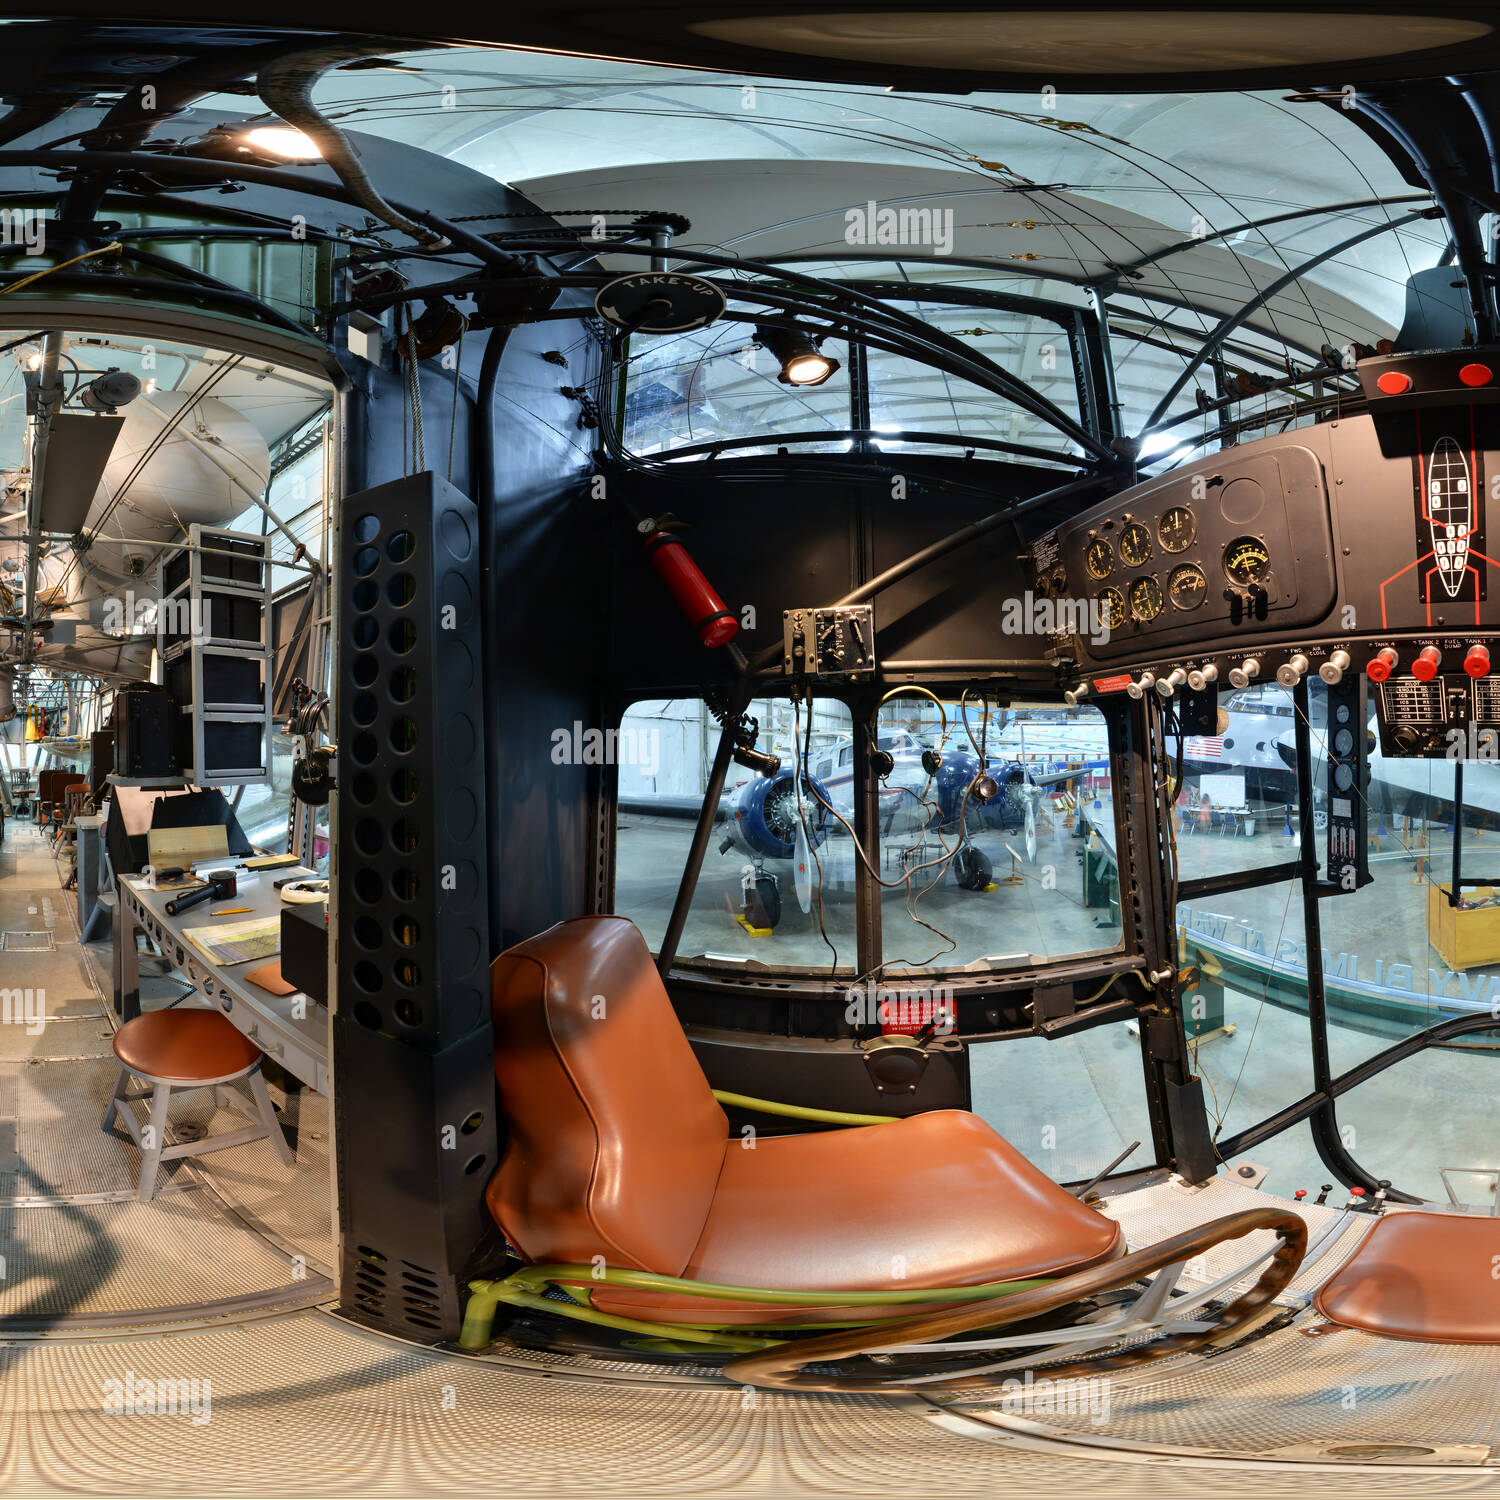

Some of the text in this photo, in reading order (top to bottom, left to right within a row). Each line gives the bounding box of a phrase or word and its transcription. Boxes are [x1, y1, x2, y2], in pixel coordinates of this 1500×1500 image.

[622, 276, 714, 296] TAKE-UP
[1449, 710, 1465, 719] 2 2
